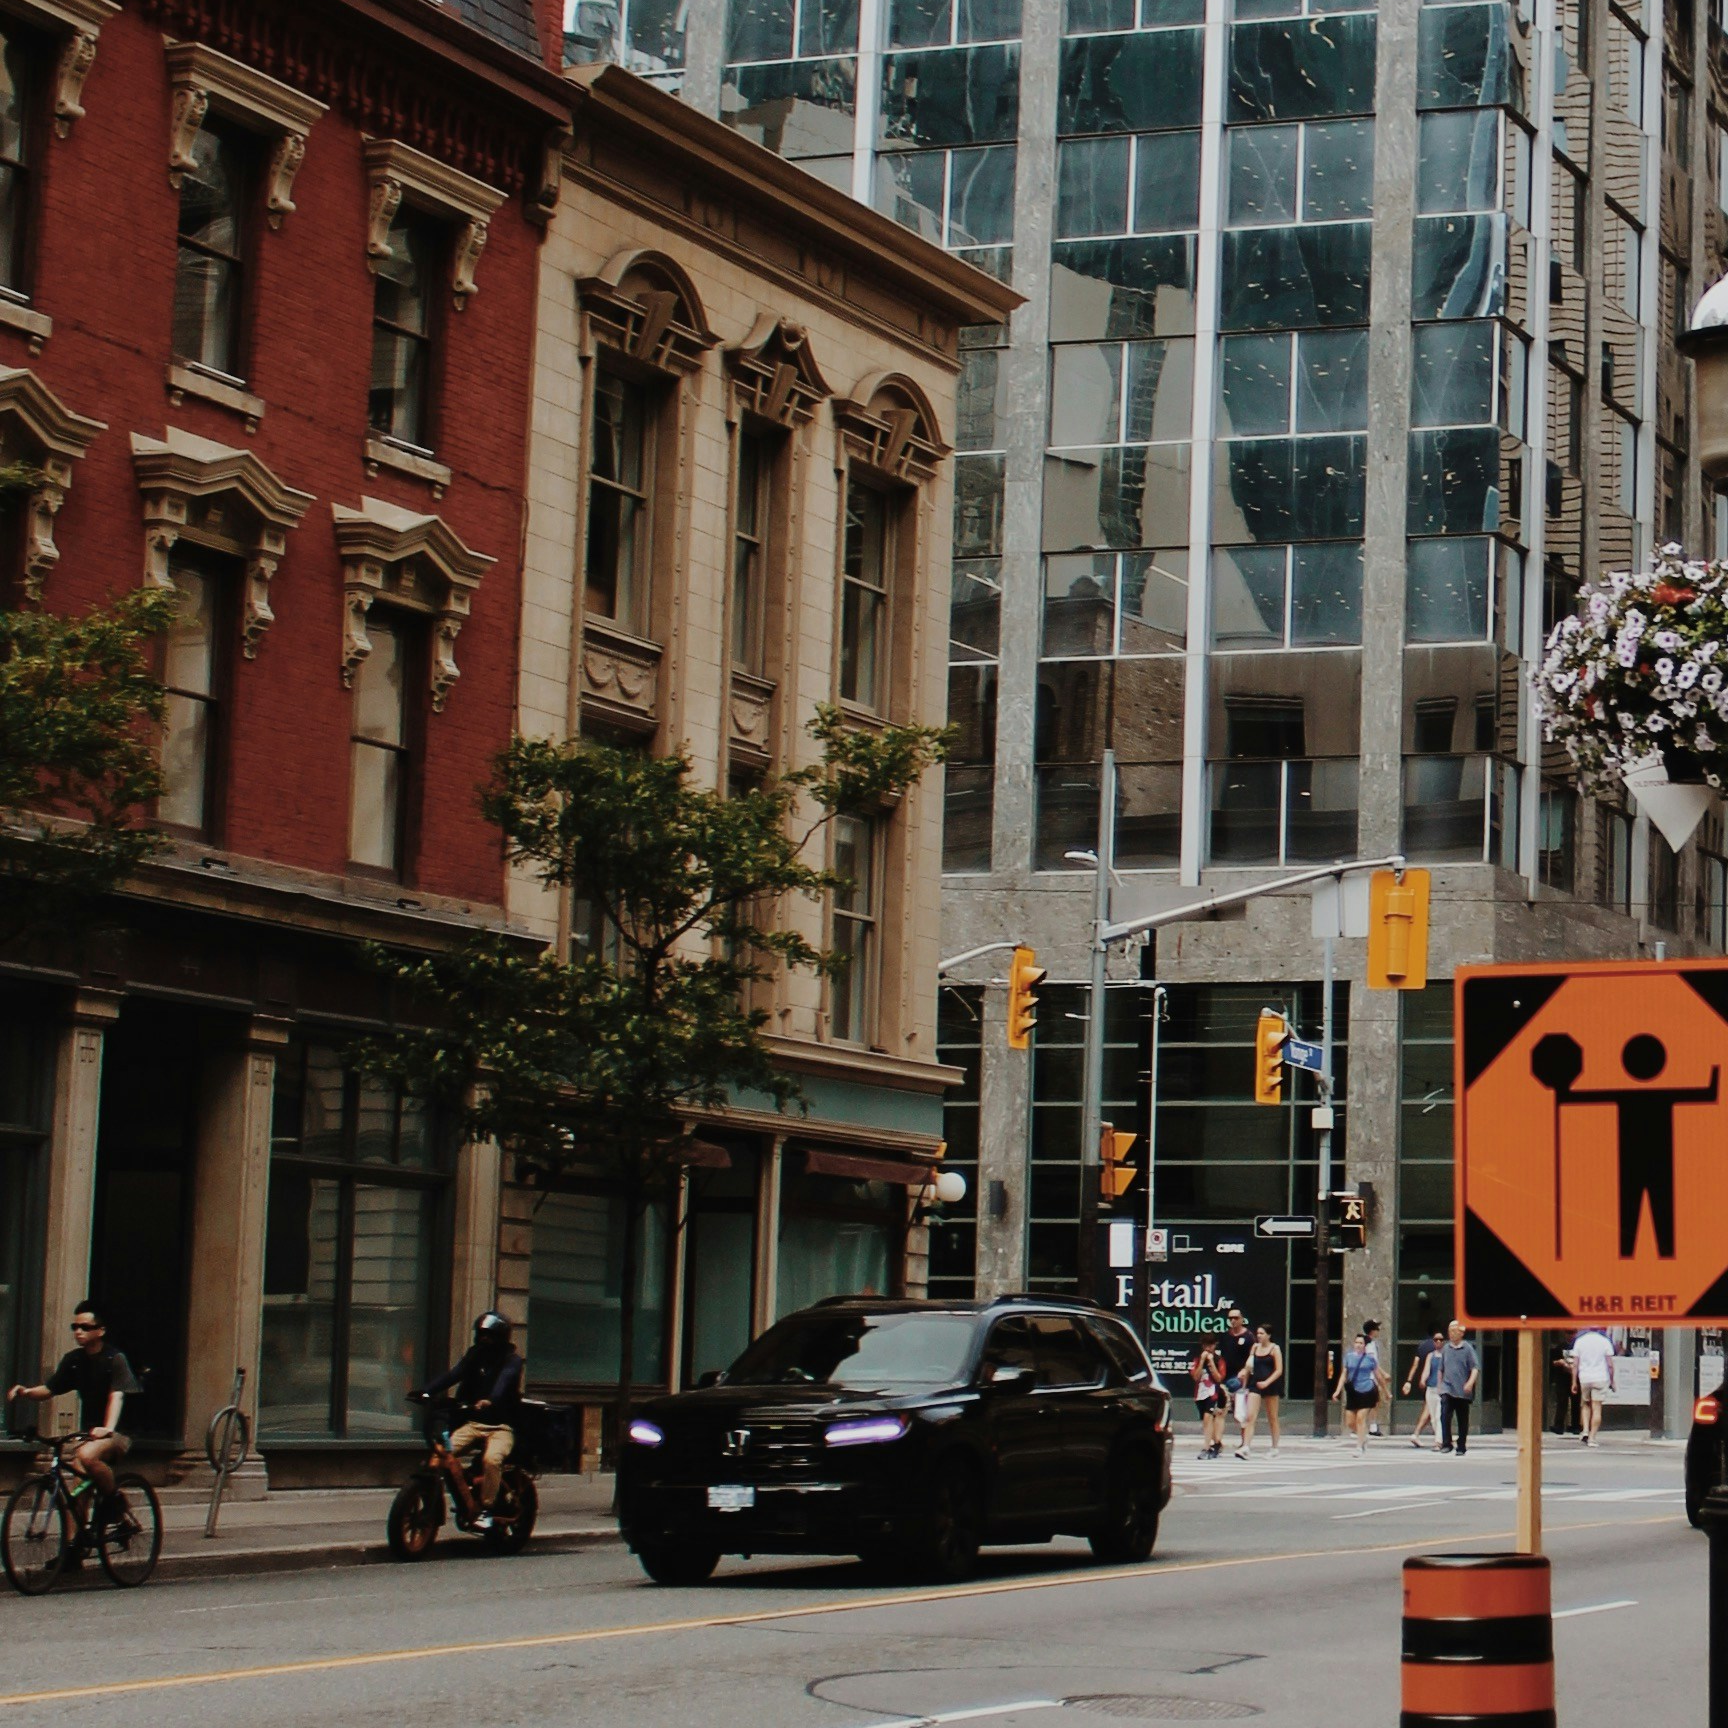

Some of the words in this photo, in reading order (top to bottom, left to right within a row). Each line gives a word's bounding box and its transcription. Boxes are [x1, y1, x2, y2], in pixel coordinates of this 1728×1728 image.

[1213, 1296, 1235, 1312] for
[1579, 1295, 1623, 1313] H&R
[1630, 1294, 1677, 1312] REIT
